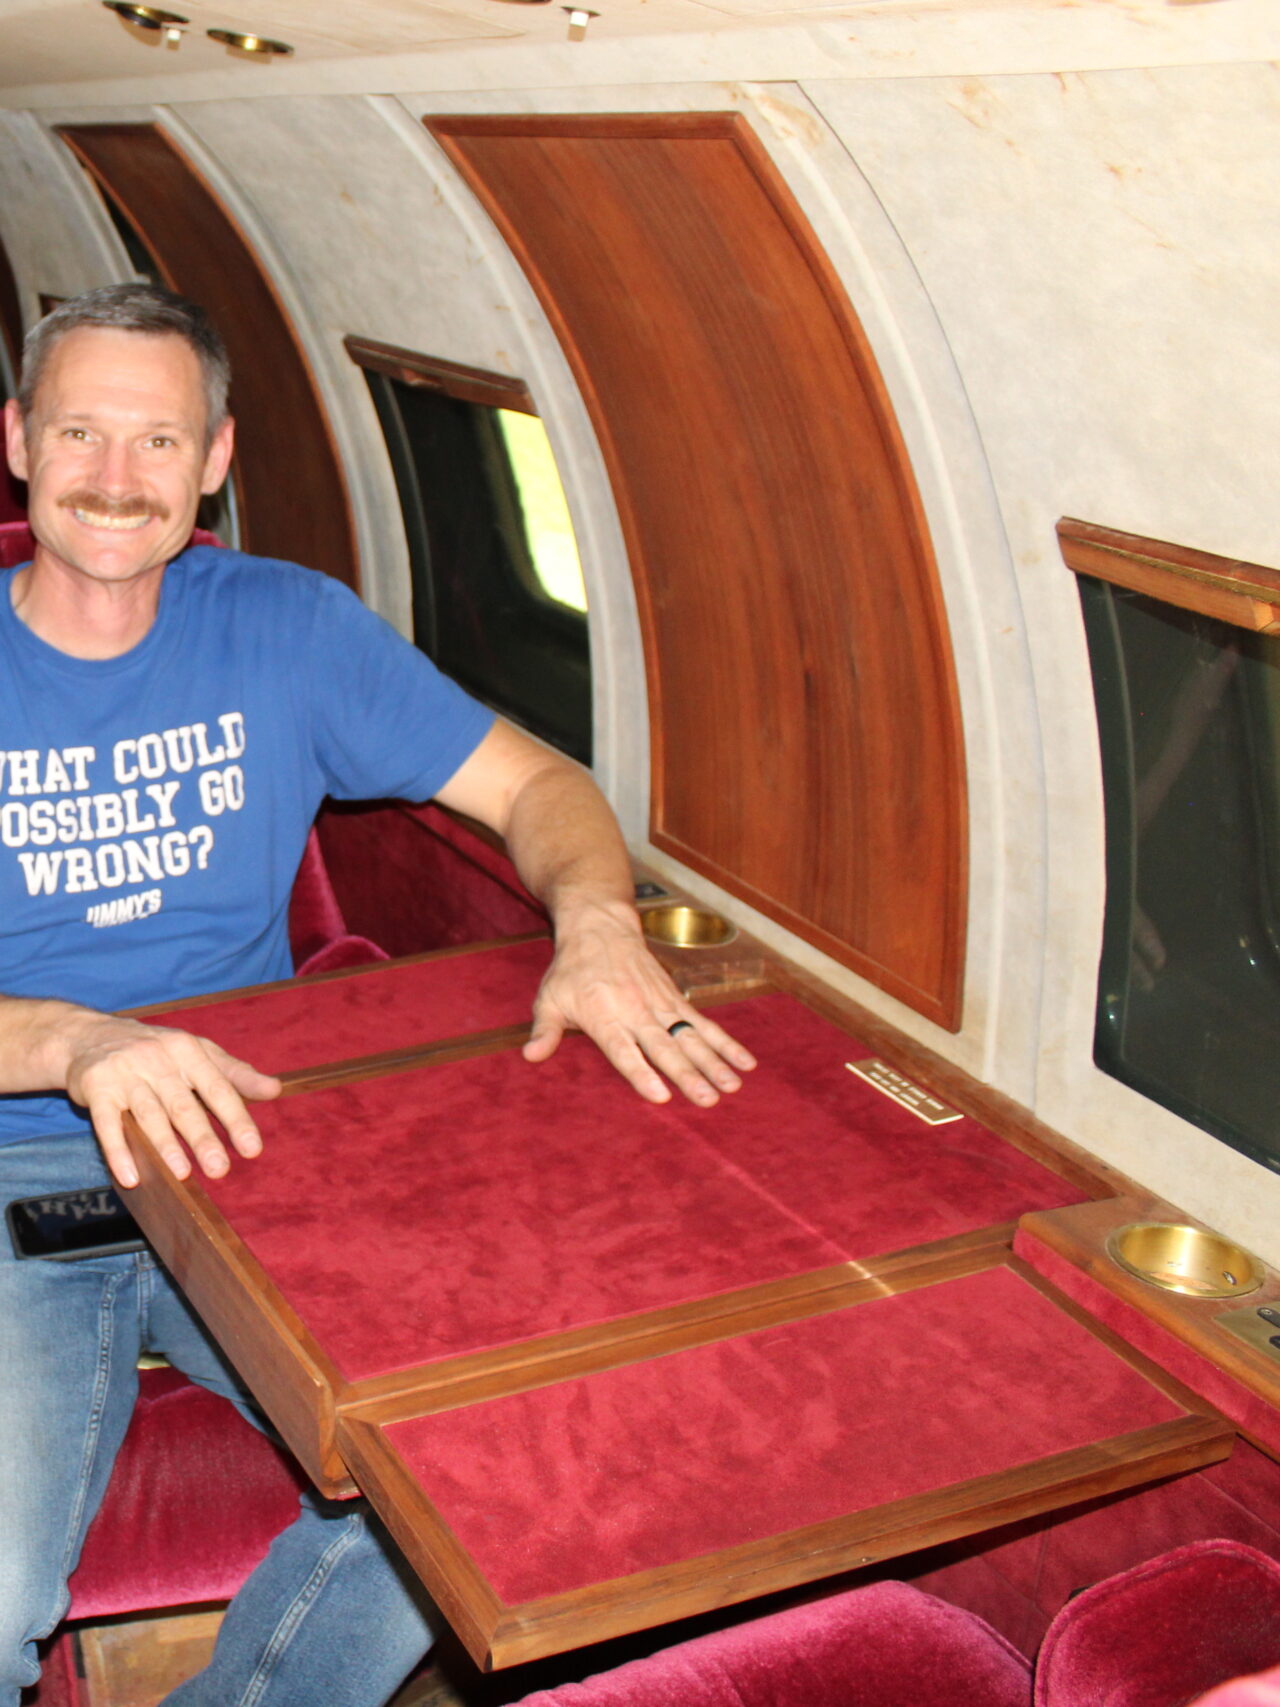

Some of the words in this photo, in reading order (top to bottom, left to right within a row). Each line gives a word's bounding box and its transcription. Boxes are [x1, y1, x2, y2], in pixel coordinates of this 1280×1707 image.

[113, 711, 246, 784] COULD
[198, 765, 245, 816] GO
[17, 824, 214, 896] WRONG?
